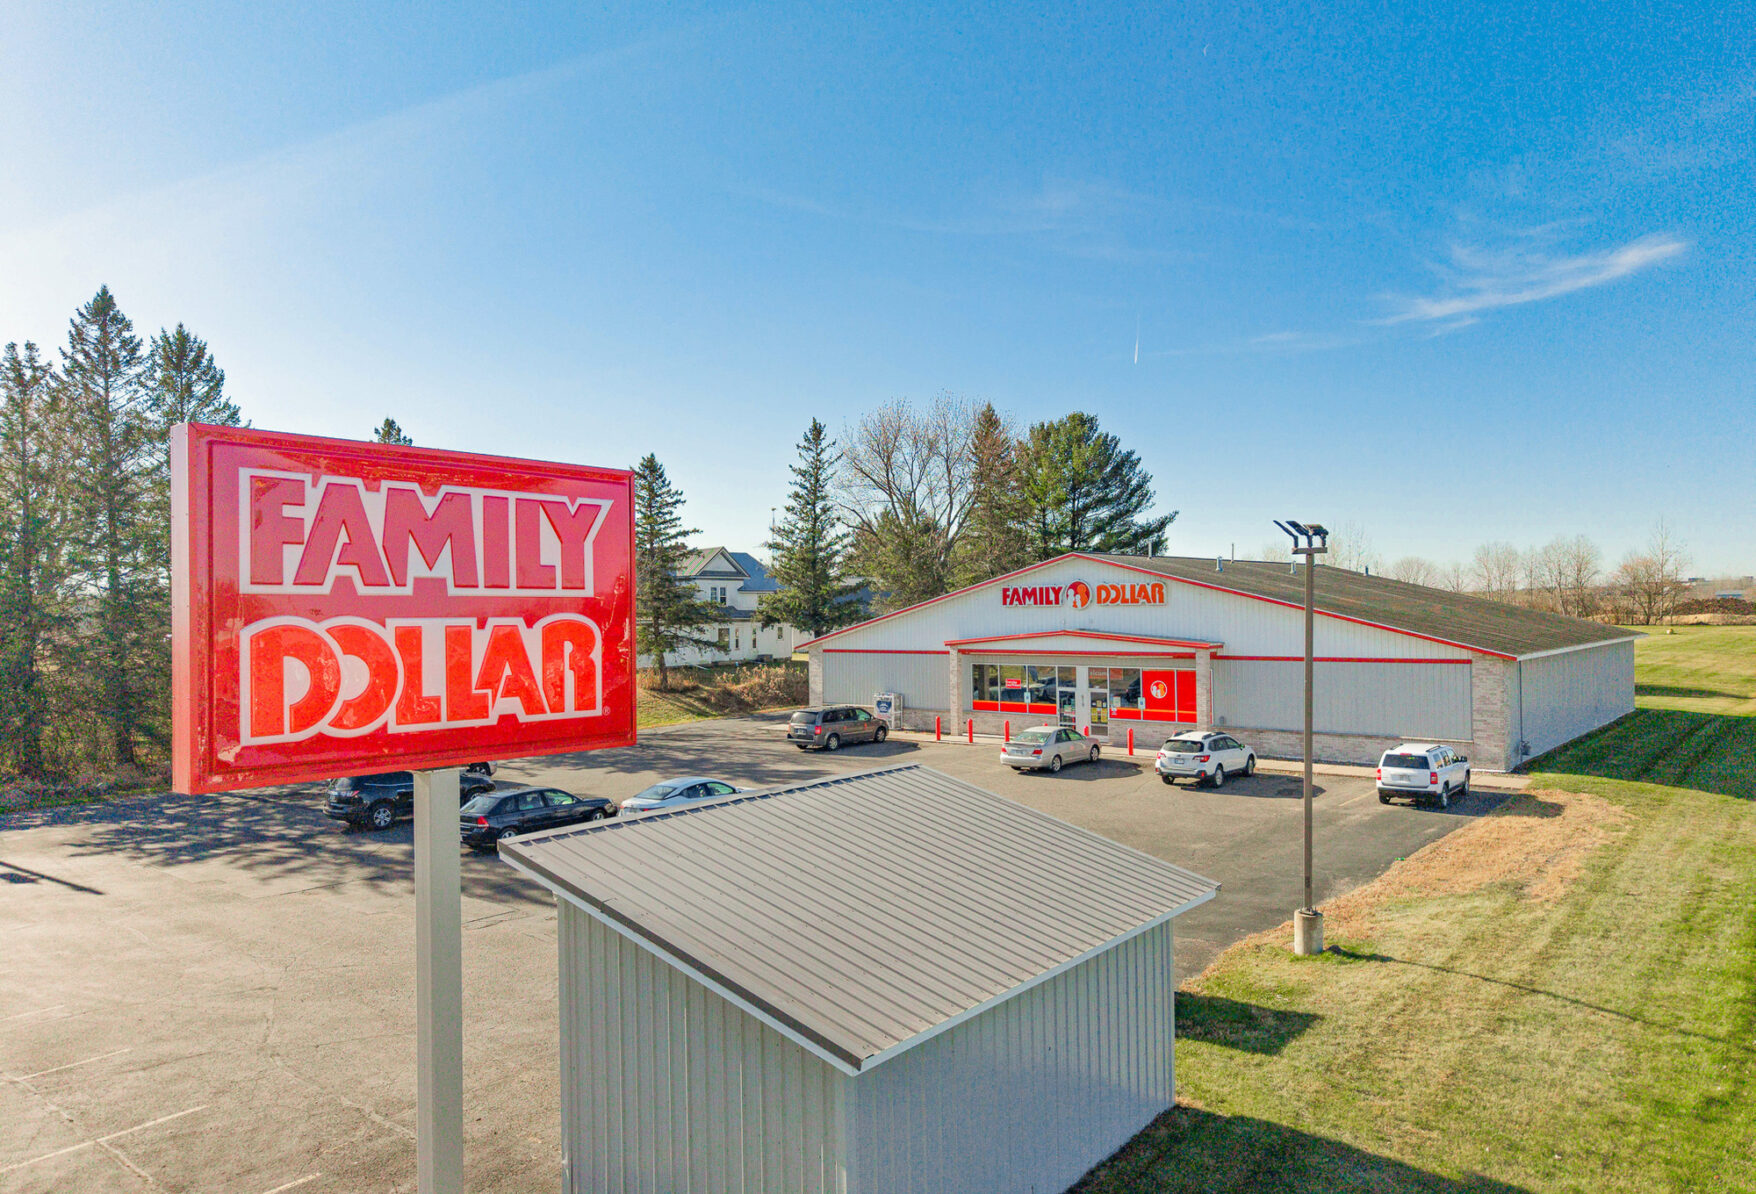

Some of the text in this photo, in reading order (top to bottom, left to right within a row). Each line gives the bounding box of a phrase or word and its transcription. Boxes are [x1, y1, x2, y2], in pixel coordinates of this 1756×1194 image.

[248, 473, 603, 591] FAMILY
[1002, 582, 1165, 606] FAMILY DOLLAR
[248, 618, 599, 739] DOLLAR
